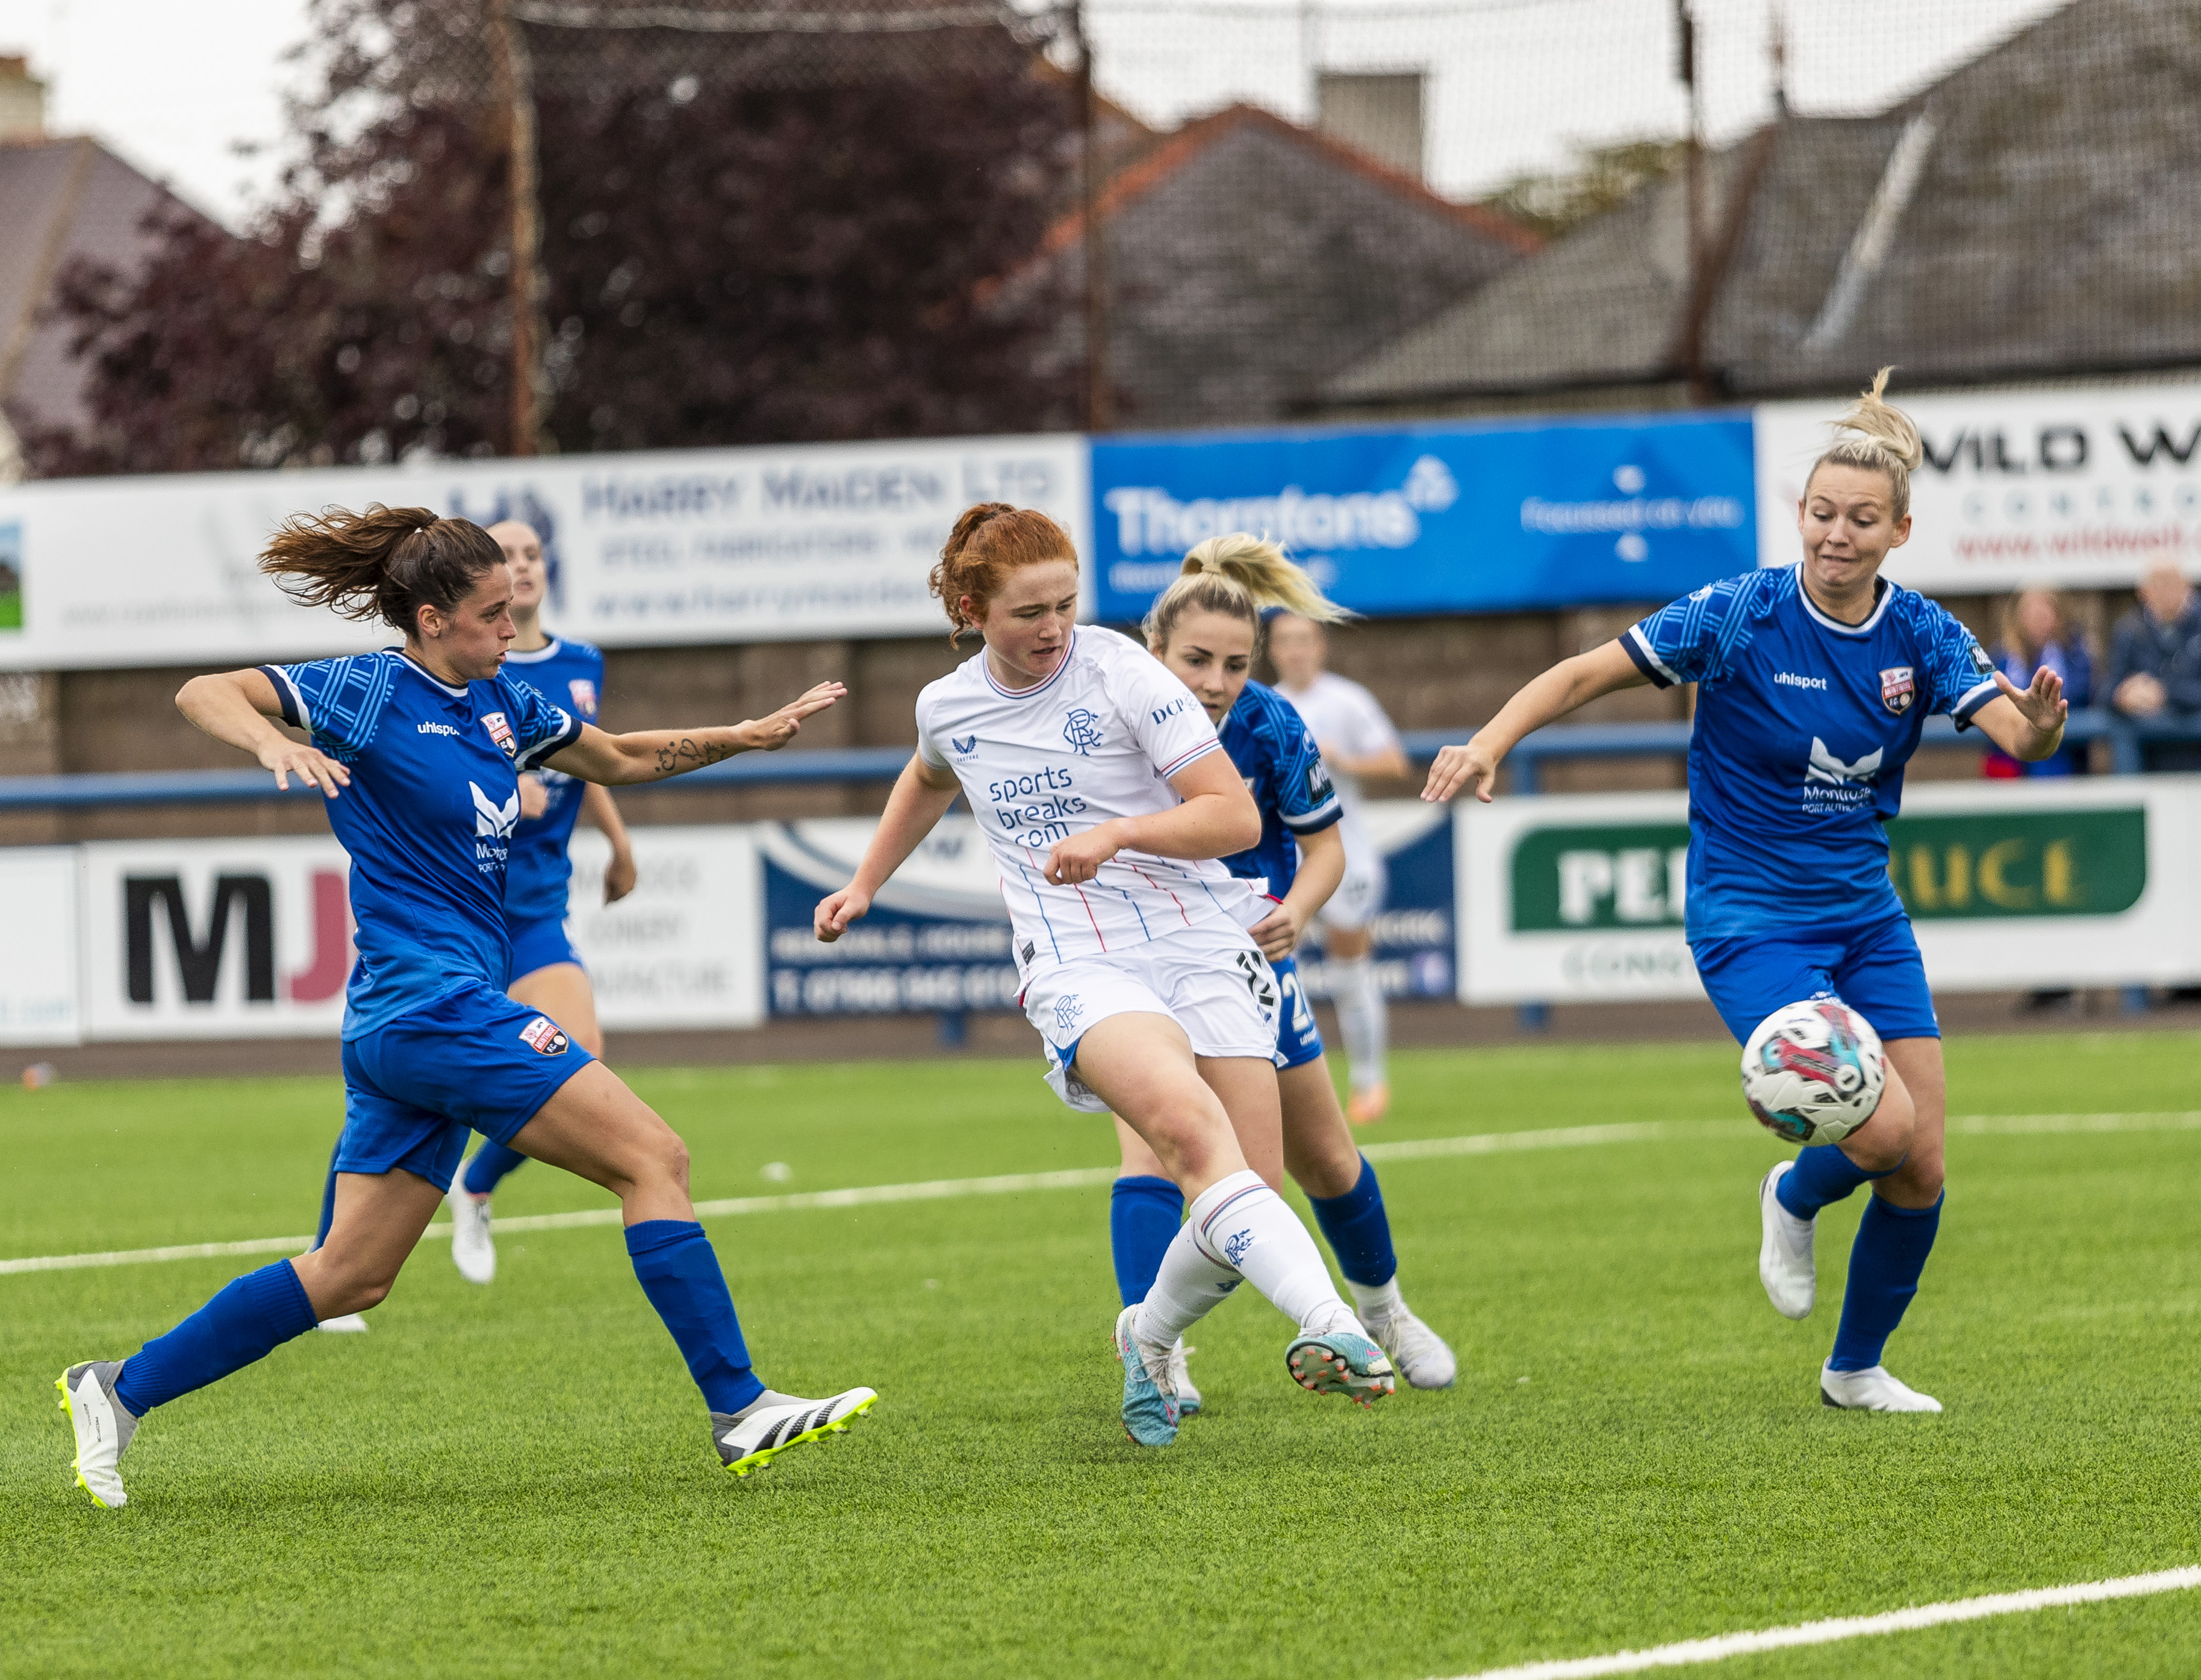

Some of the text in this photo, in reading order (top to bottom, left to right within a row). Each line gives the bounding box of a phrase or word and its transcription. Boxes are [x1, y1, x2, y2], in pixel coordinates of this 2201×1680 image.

[1774, 671, 1827, 691] uhlsport
[1151, 698, 1183, 725] DCP
[417, 721, 459, 736] uhlspo
[989, 766, 1072, 803] sports
[996, 795, 1086, 830] breaks
